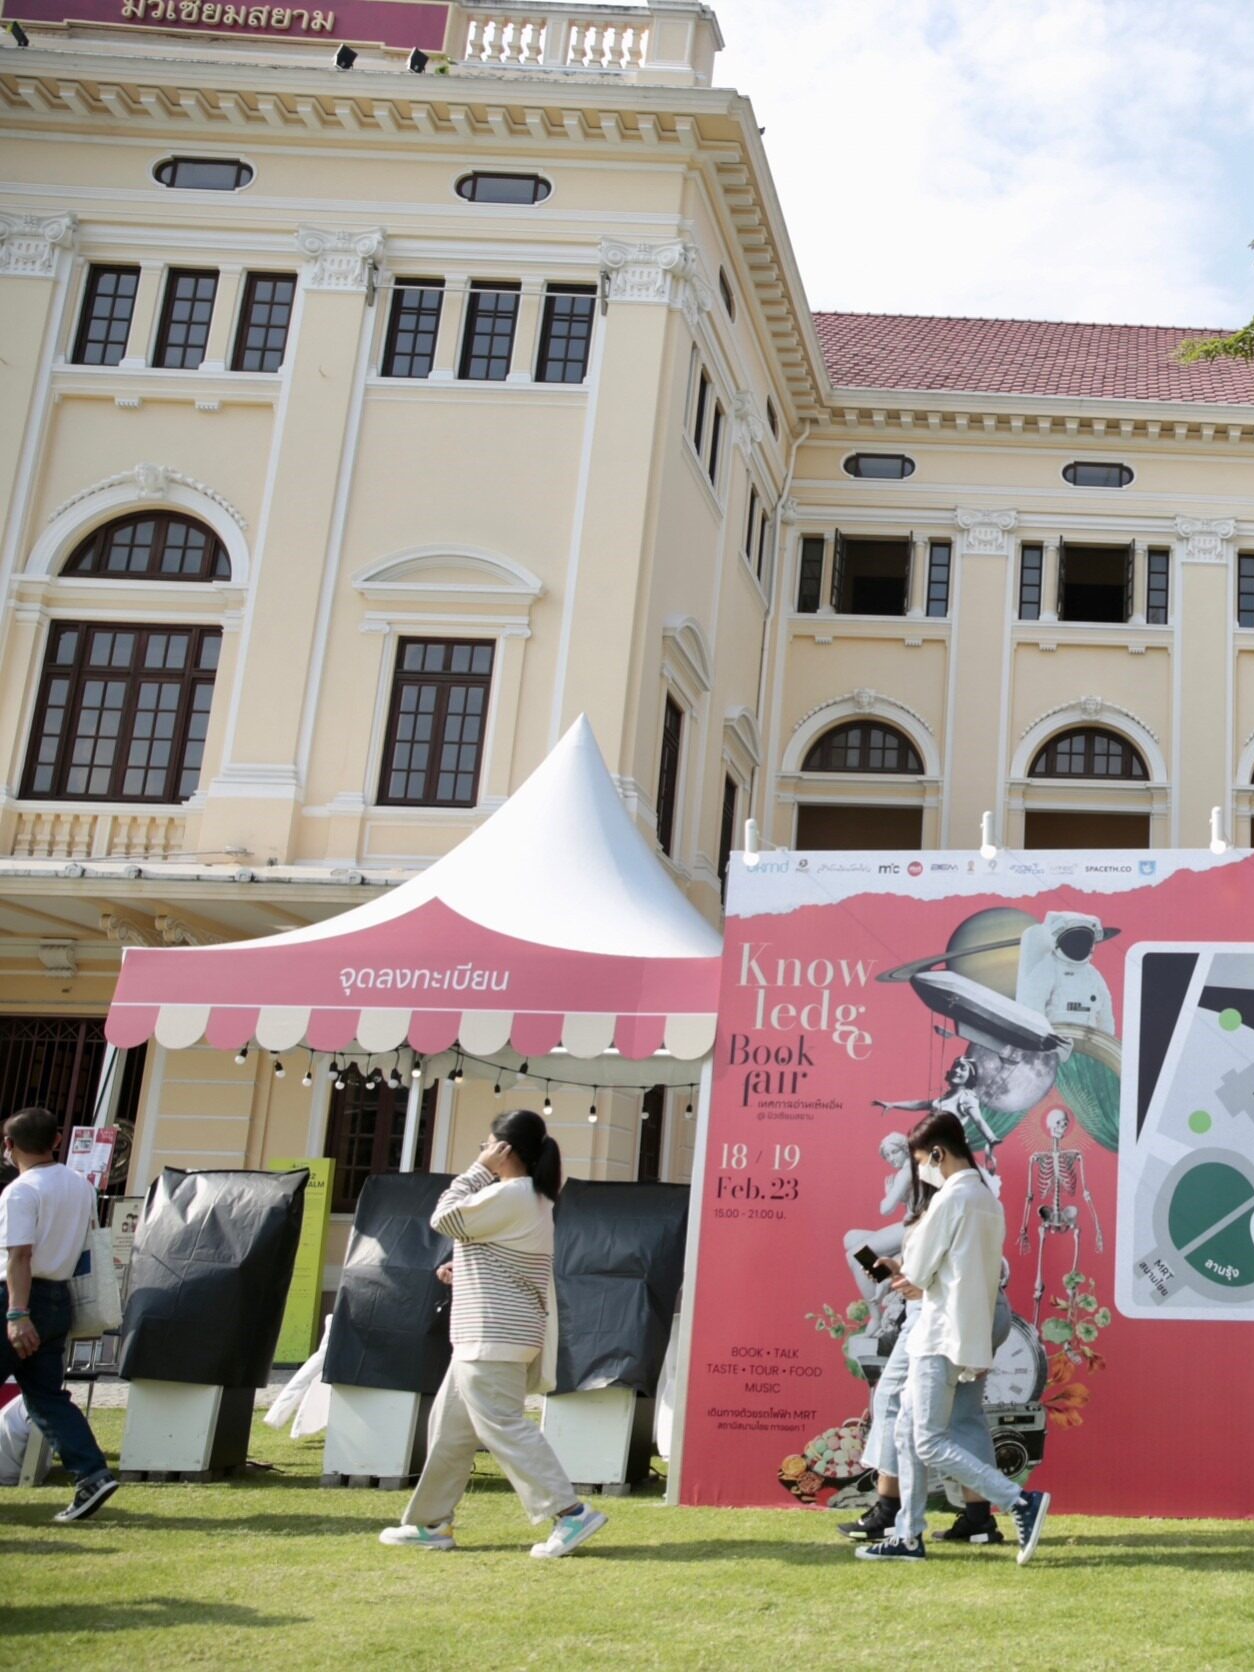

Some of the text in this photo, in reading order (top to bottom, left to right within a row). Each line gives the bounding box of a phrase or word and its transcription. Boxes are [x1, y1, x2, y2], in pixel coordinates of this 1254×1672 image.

[1085, 865, 1132, 873] SPACETH.CO
[736, 942, 878, 988] Know
[338, 962, 510, 996] จุดลงทะเบียน
[729, 1034, 815, 1066] Book
[719, 1144, 747, 1170] 18
[772, 1144, 800, 1170] 19
[716, 1177, 799, 1201] Feb. 23
[1154, 1259, 1174, 1281] MRT
[731, 1346, 800, 1358] BOOK TALK
[706, 1364, 822, 1377] TASTE TOUR FOOD
[744, 1383, 780, 1394] MUSIC
[794, 1410, 816, 1420] MRT
